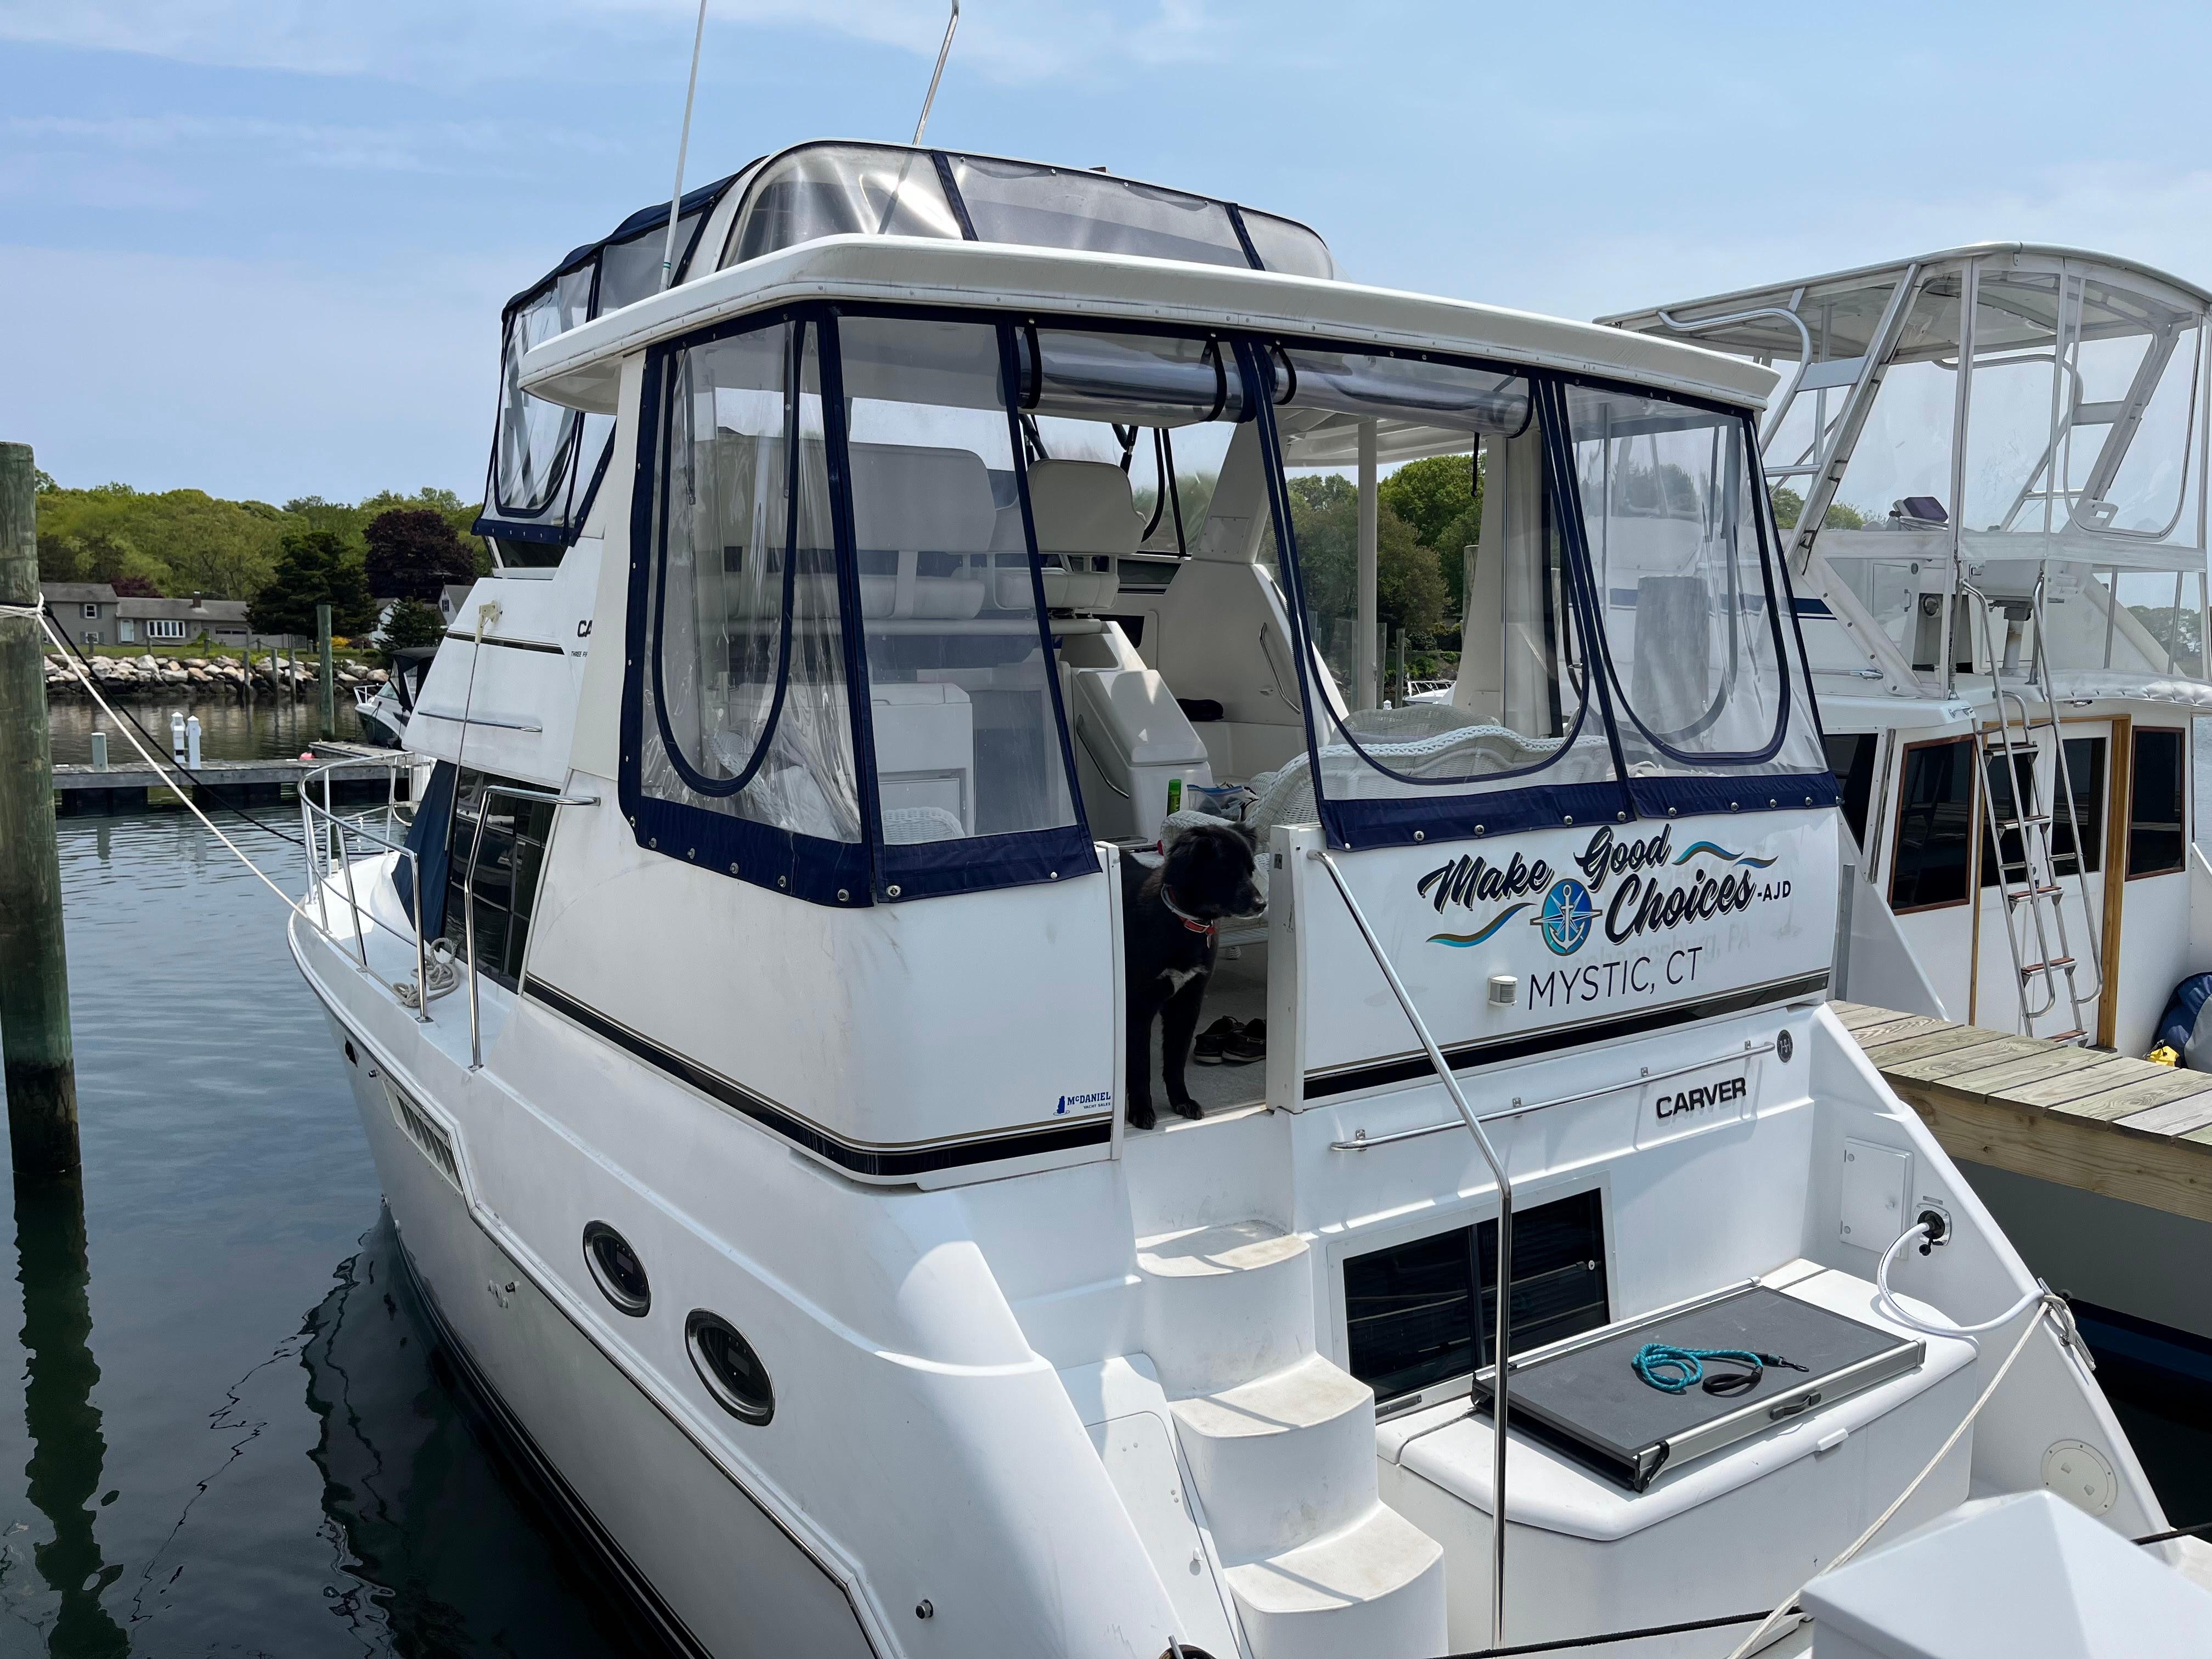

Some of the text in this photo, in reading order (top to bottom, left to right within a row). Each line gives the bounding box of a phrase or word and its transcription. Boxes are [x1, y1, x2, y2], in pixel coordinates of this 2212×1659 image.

[1417, 823, 1672, 915] Make Good
[1605, 868, 1757, 945] Choices
[1528, 946, 1703, 1011] MYSTIC, CT
[1656, 1076, 1747, 1119] CARVER
